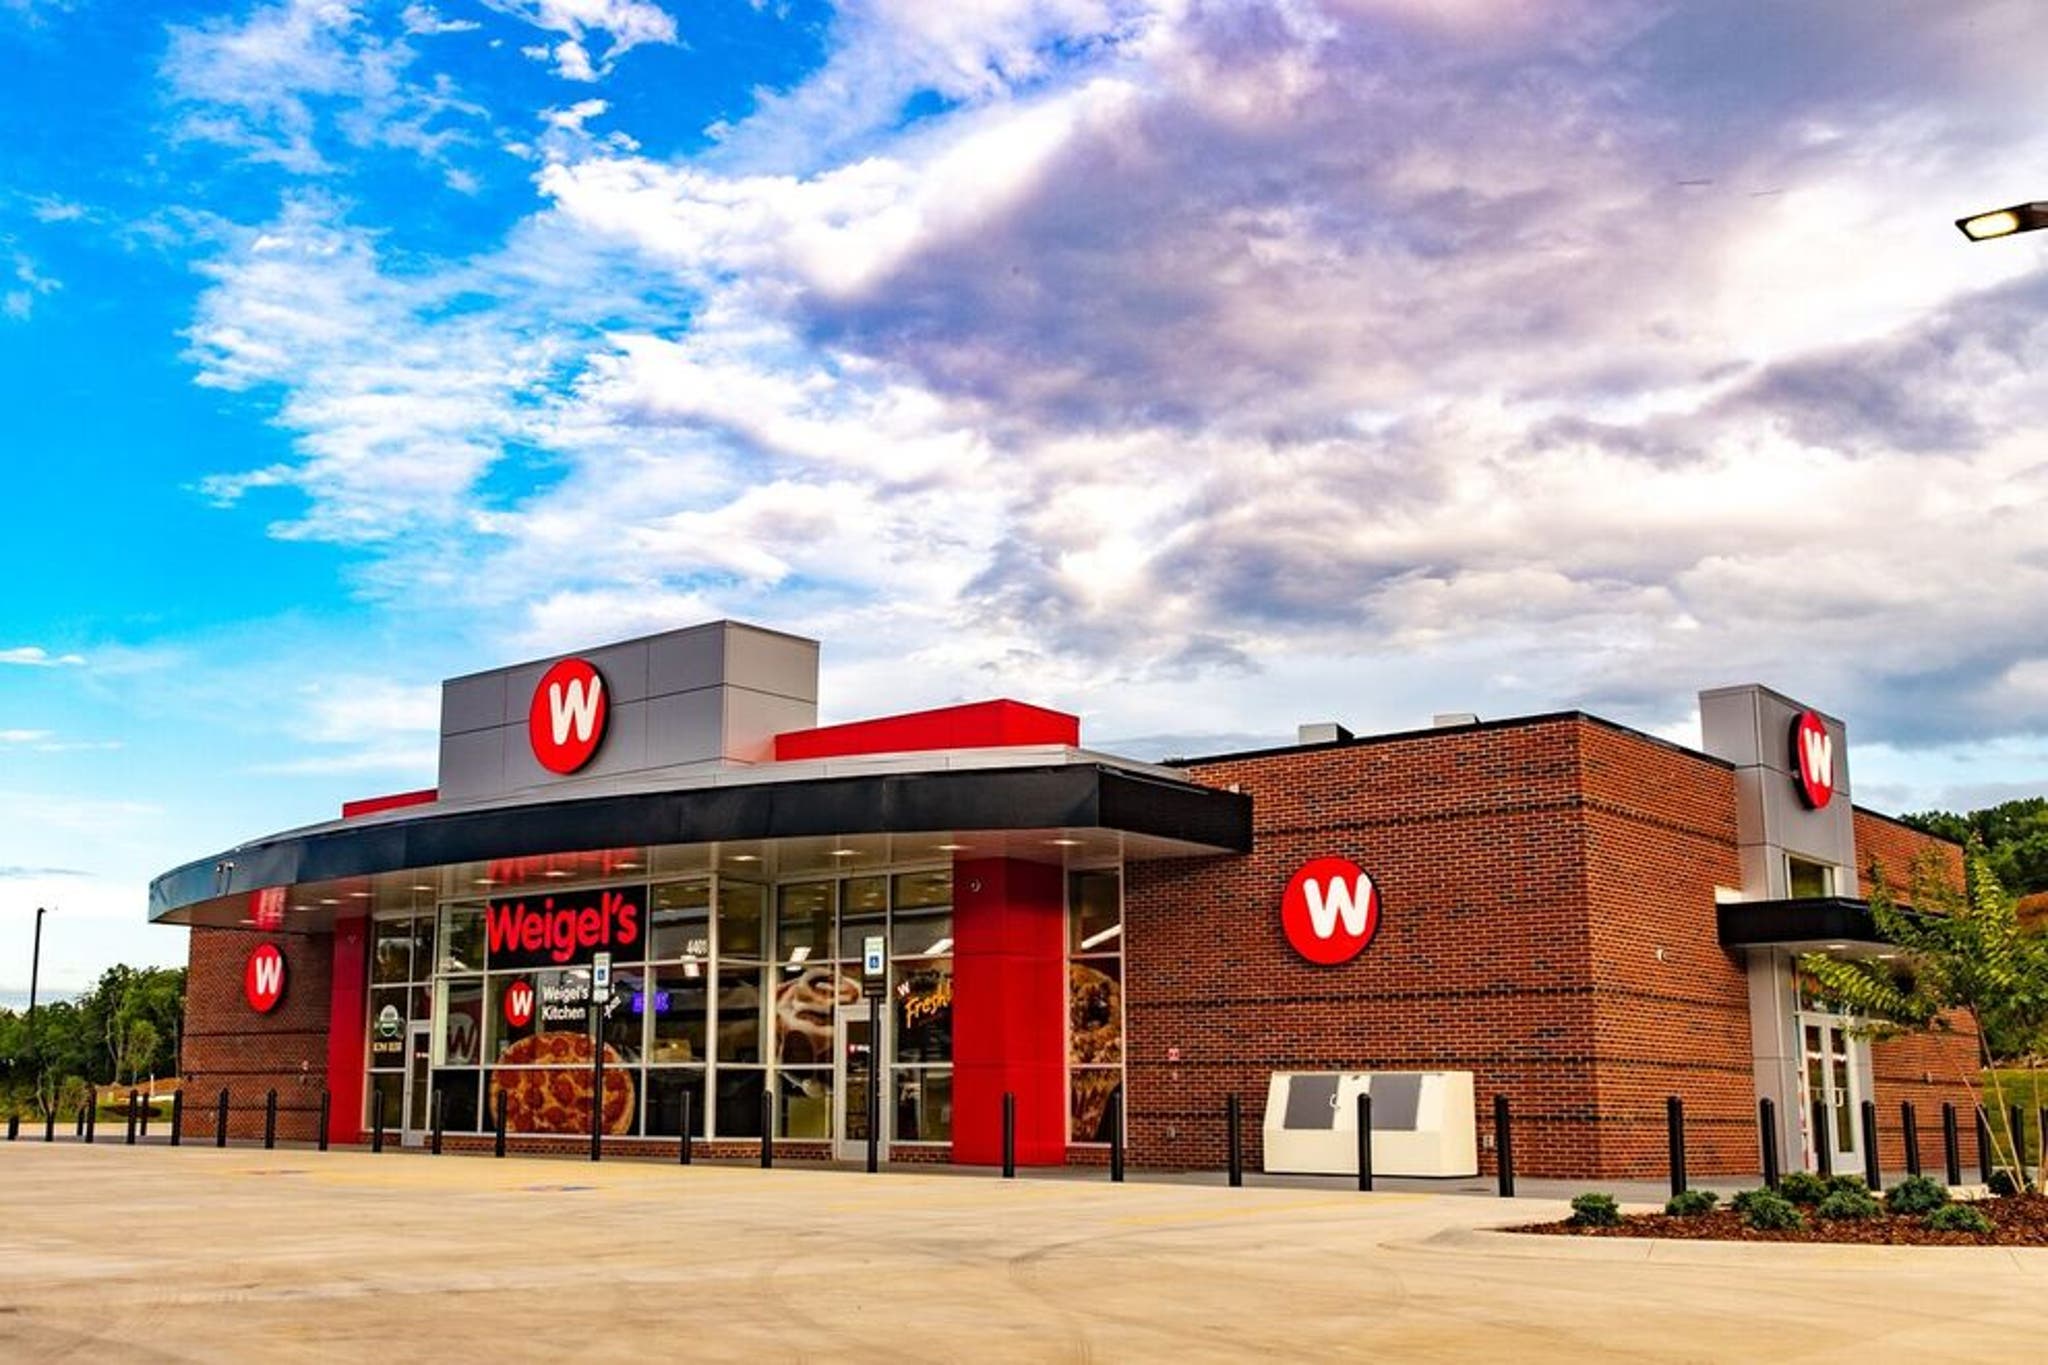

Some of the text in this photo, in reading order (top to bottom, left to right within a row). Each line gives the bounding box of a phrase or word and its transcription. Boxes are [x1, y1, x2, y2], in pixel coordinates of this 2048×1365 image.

[550, 676, 600, 744] W
[1804, 727, 1832, 788] W
[486, 891, 638, 963] Weigel's
[1304, 874, 1371, 938] W
[256, 956, 282, 995] W
[542, 984, 590, 1003] Weigel's
[513, 991, 532, 1015] W
[541, 1005, 586, 1020] Kitchen
